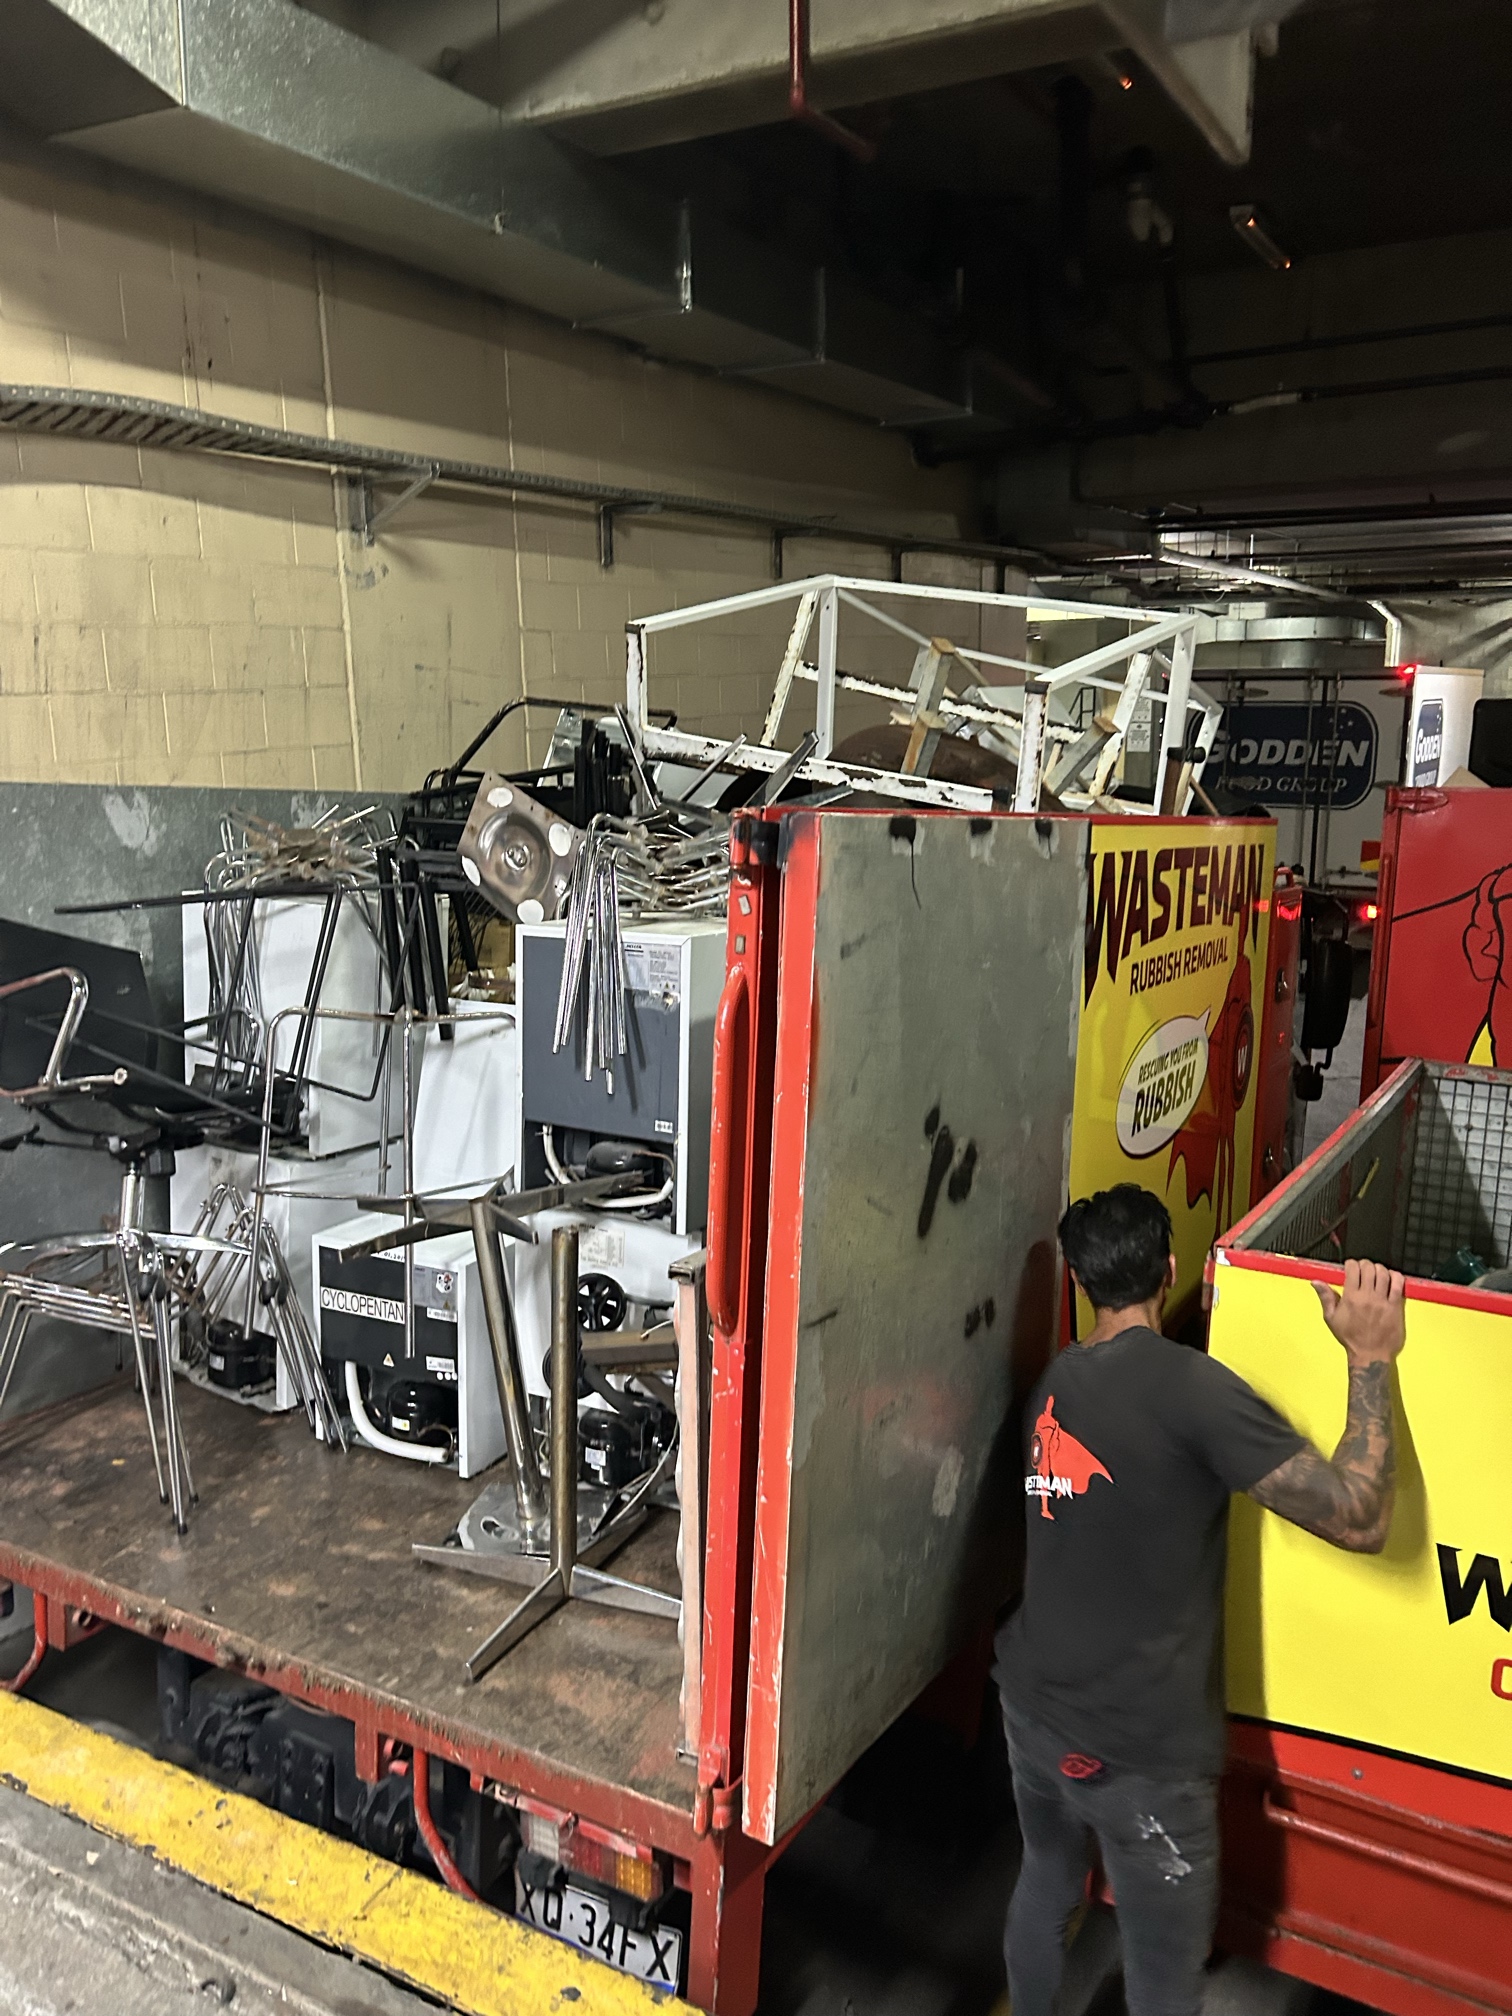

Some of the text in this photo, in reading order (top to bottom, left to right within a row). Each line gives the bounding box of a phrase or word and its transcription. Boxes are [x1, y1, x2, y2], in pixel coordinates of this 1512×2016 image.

[1206, 729, 1370, 767] GODDEN
[1085, 844, 1265, 1009] WASTEMAN
[1130, 936, 1228, 996] RUBBISH REMOVAL
[1137, 1038, 1199, 1085] RESCUING YOU FROM
[1131, 1060, 1196, 1137] RUBBISH
